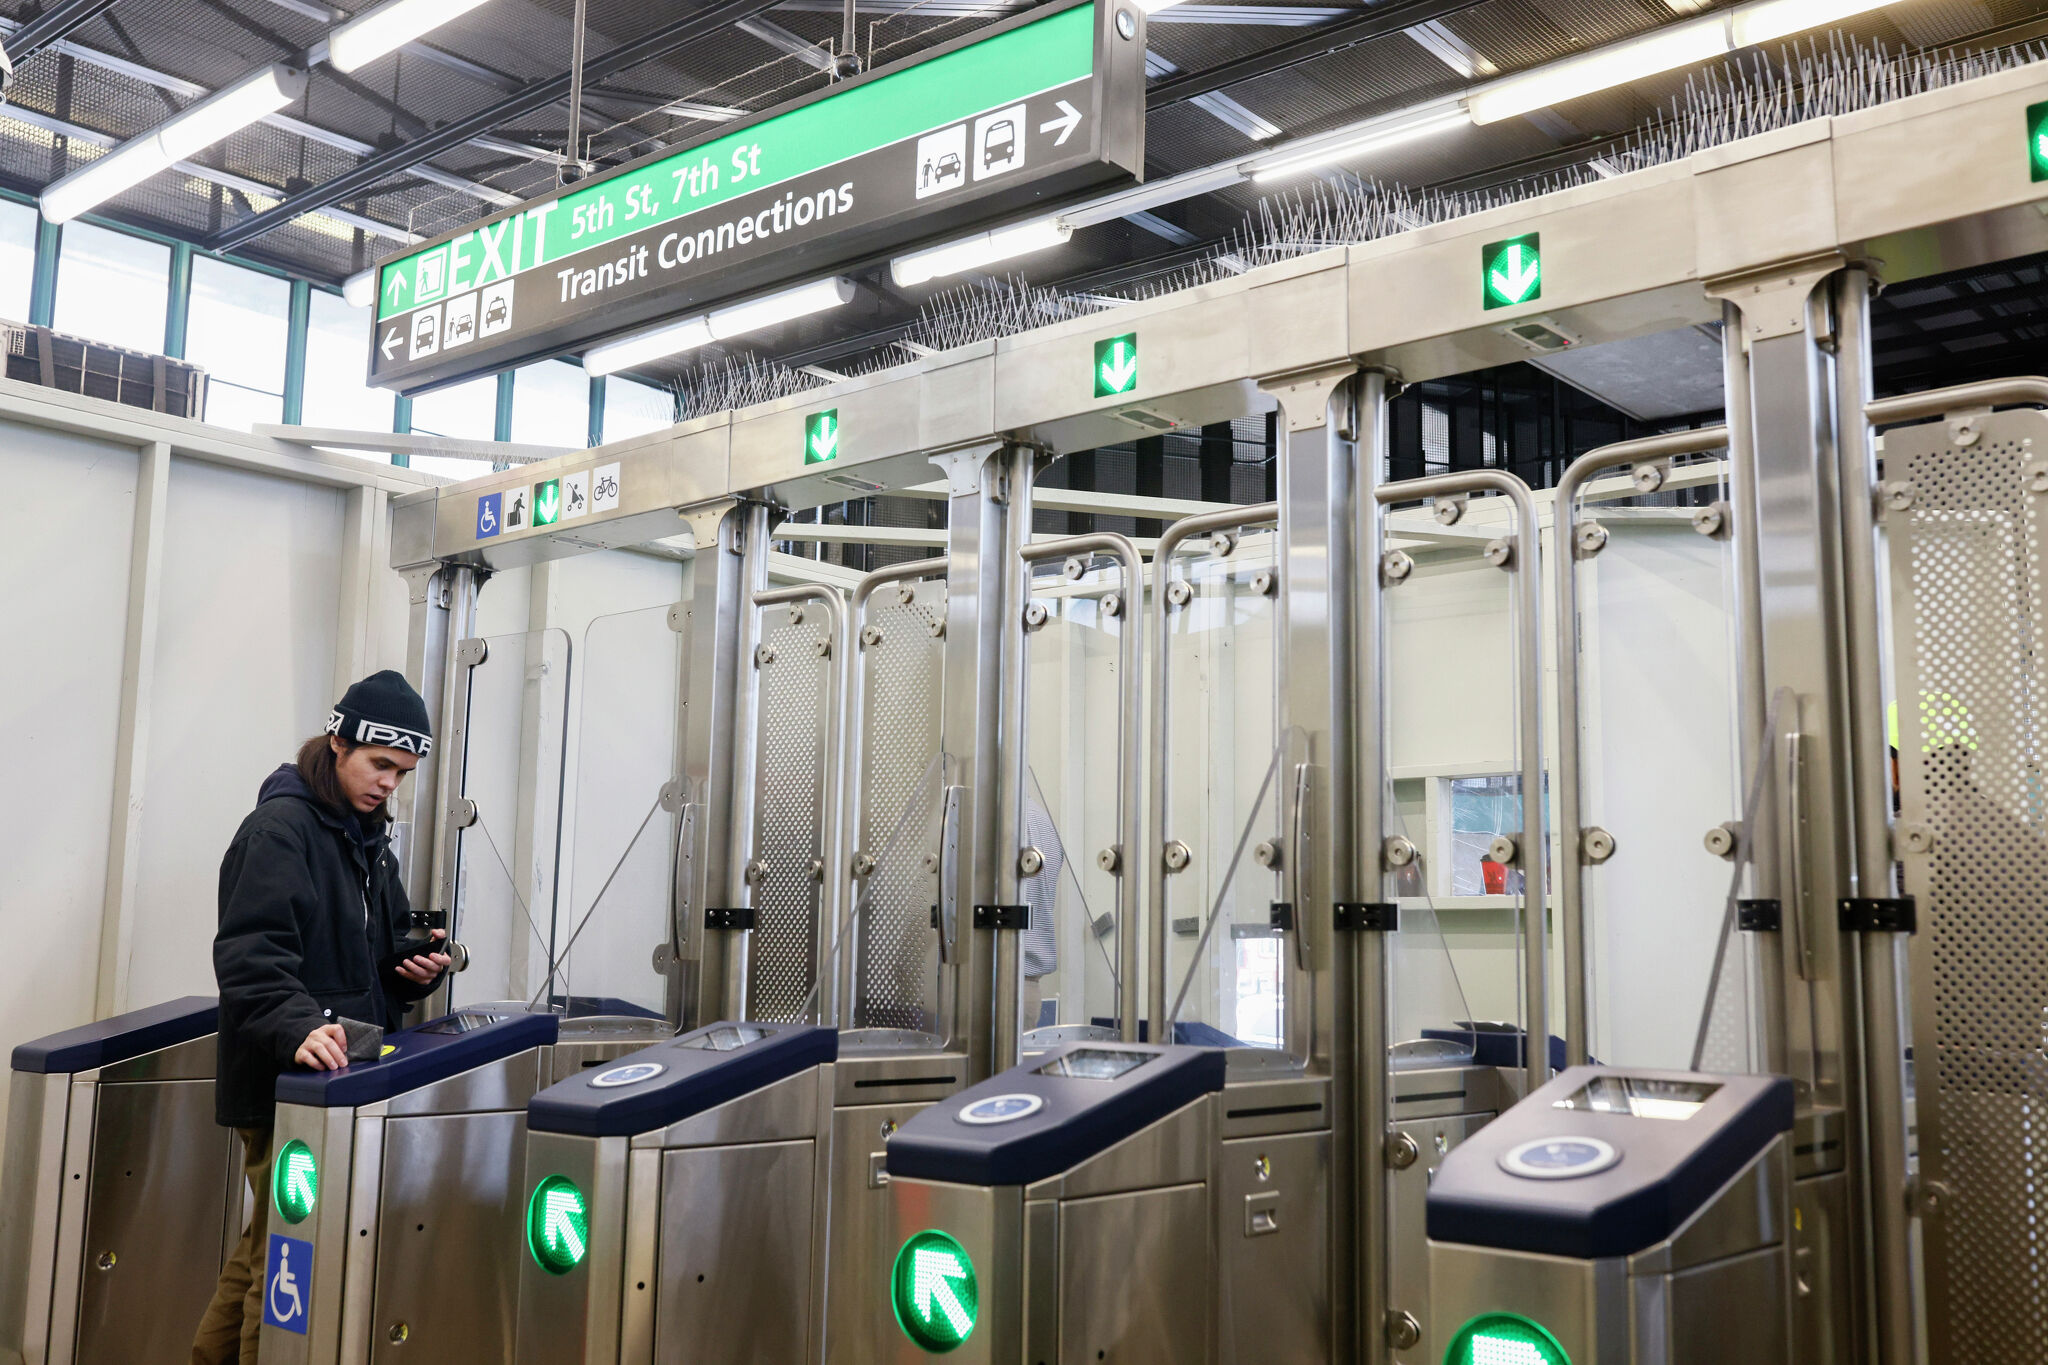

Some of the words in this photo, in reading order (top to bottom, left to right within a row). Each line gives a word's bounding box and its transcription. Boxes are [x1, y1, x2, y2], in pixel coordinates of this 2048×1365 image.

[447, 200, 558, 297] EXIT
[571, 195, 614, 239] 5th
[625, 184, 660, 221] St,
[672, 157, 719, 204] 7th
[731, 144, 762, 183] St
[557, 245, 648, 302] Transit
[658, 182, 854, 269] Connections
